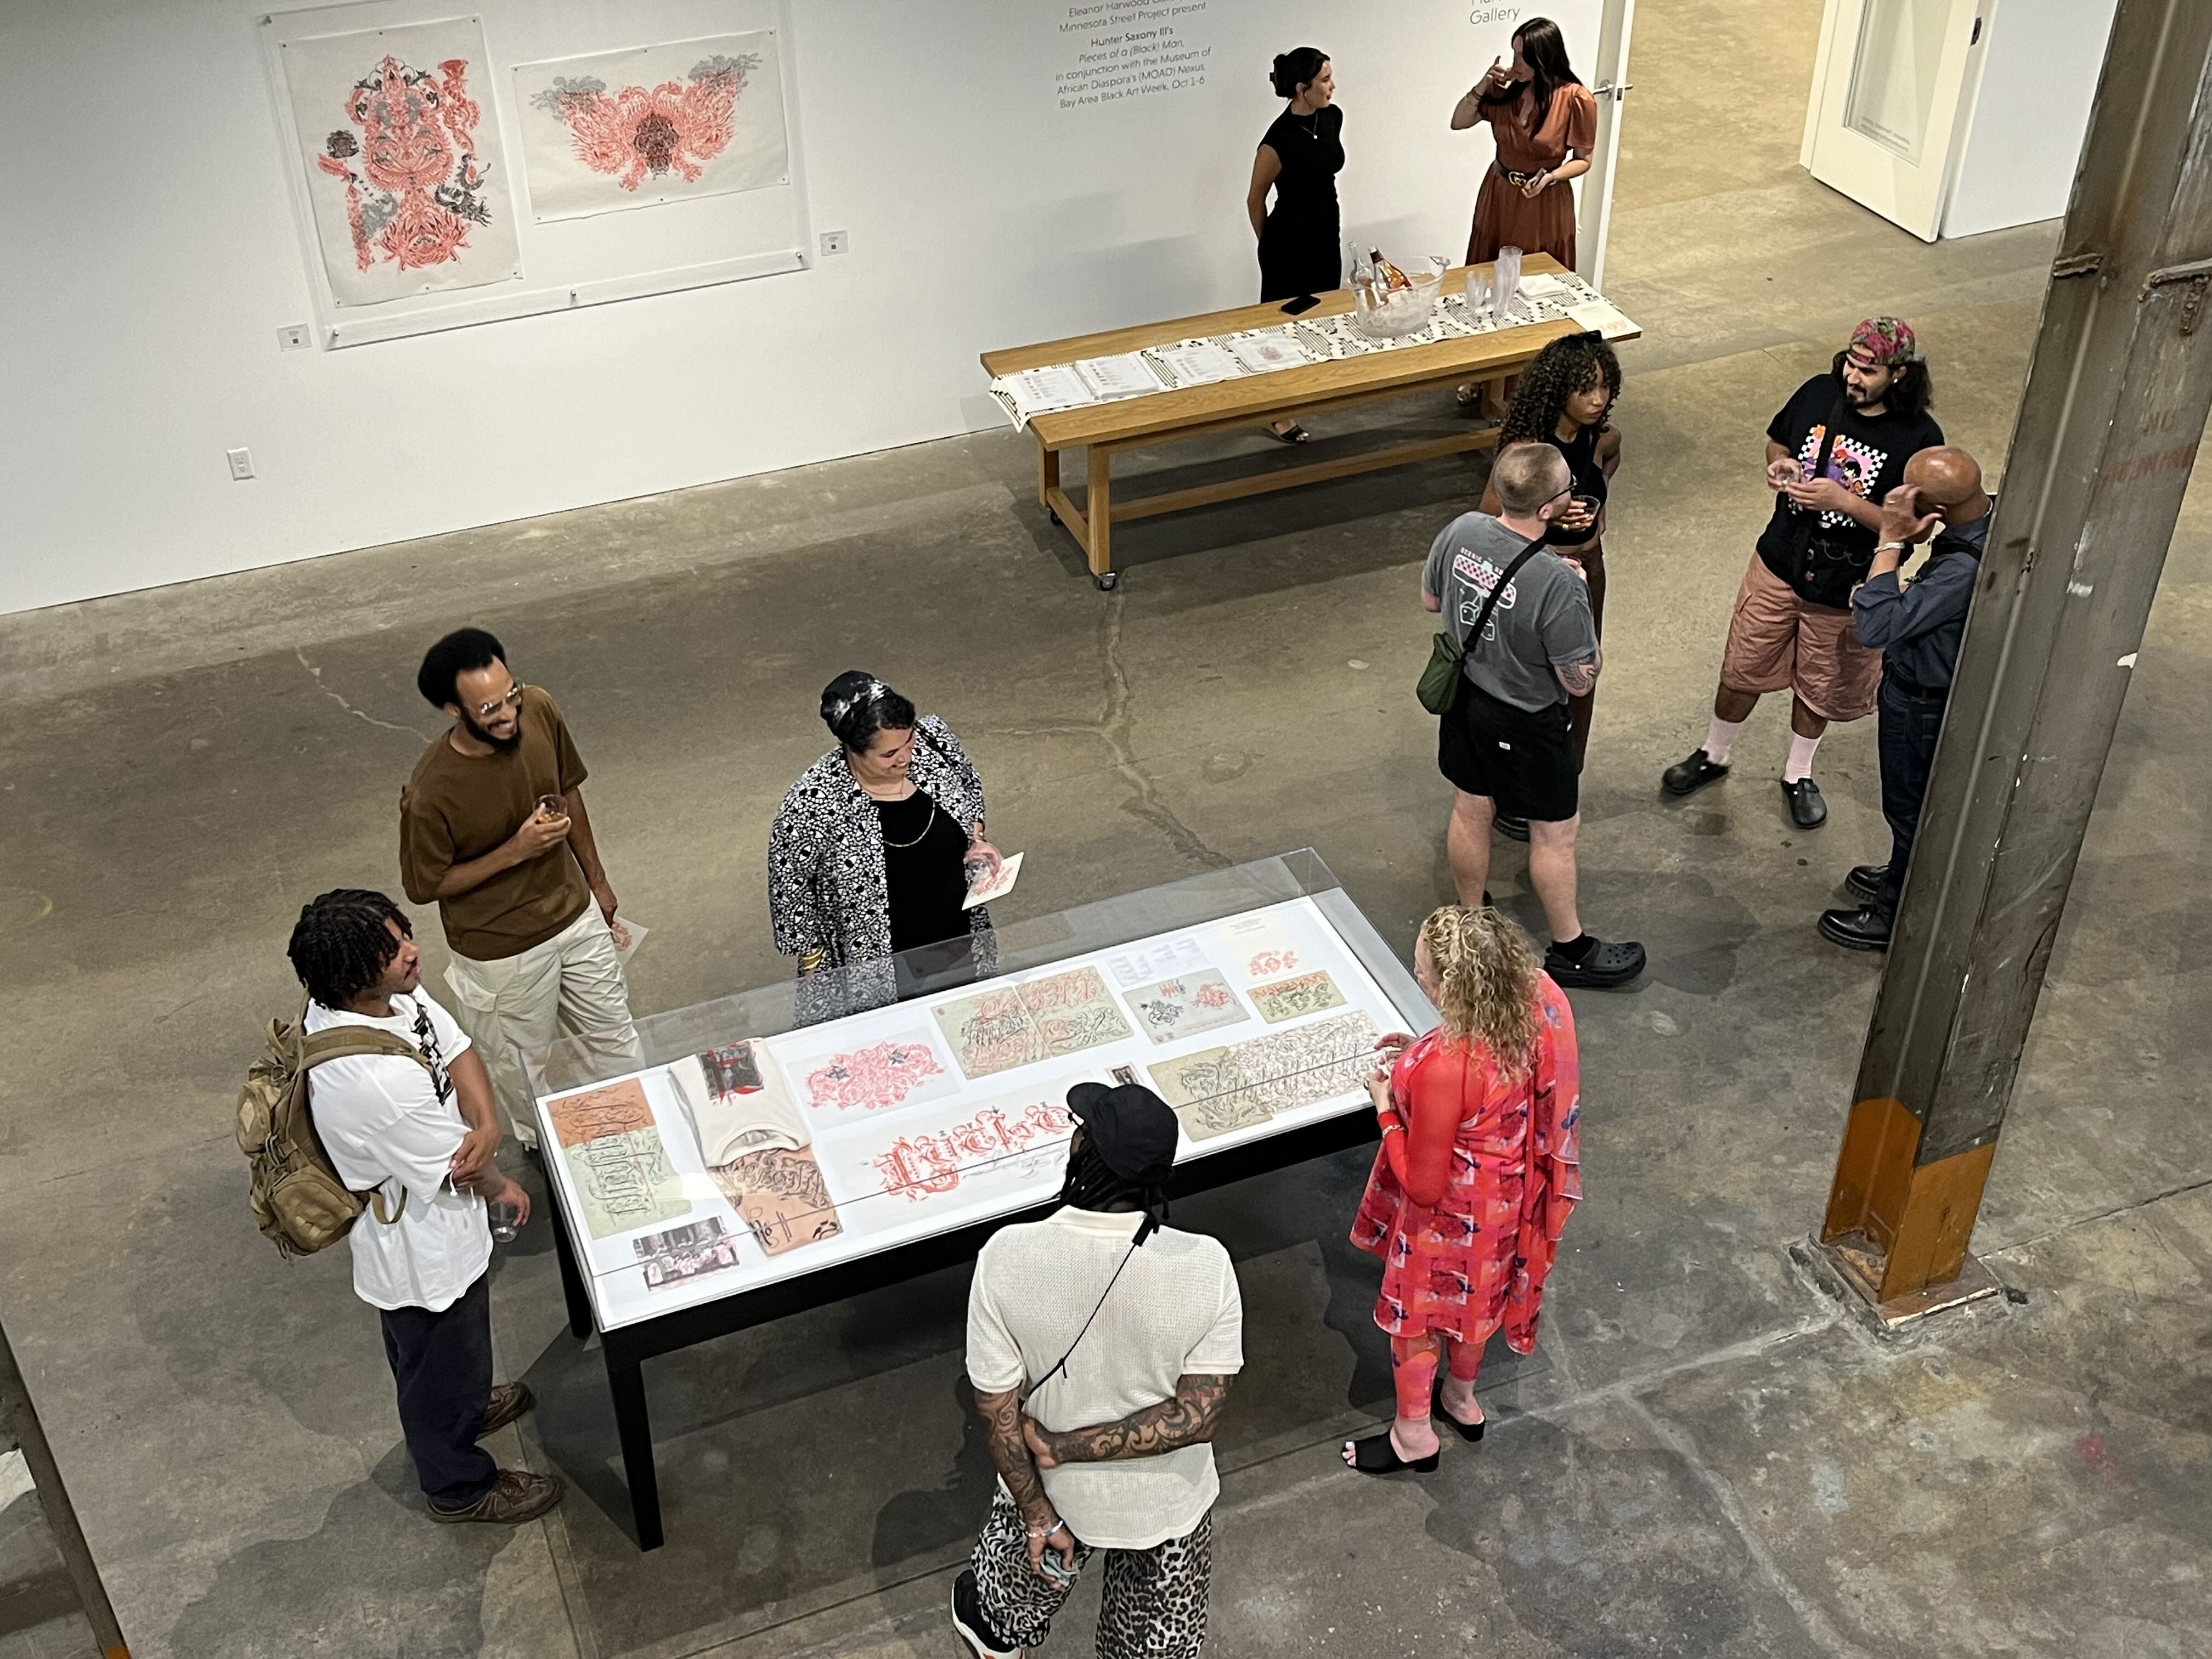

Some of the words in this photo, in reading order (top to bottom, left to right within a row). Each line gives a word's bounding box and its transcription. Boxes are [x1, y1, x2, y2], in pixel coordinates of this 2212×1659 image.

[1059, 19, 1107, 32] Minnesota
[1110, 13, 1136, 25] Street
[1138, 8, 1169, 20] Project
[1172, 2, 1206, 16] present
[1069, 5, 1104, 18] Eleanor
[1470, 8, 1520, 24] Gallery
[1079, 52, 1107, 64] Pieces
[1109, 48, 1119, 58] of
[1130, 42, 1159, 57] (Black)
[1163, 40, 1184, 49] Man,
[1091, 36, 1122, 47] Hunter
[1125, 31, 1157, 42] Saxony
[1056, 72, 1064, 81] in
[1066, 64, 1119, 80] conjunction
[1122, 59, 1141, 70] with
[1143, 57, 1158, 66] the
[1160, 50, 1199, 64] Museum
[1201, 46, 1211, 57] of
[1057, 83, 1088, 95] African
[1091, 75, 1137, 89] Diaspora's
[1139, 67, 1176, 82] (MOAD)
[1178, 64, 1206, 75] Nexus,
[1060, 99, 1076, 109] Bay
[1077, 95, 1098, 105] Area
[1101, 89, 1124, 101] Black
[1126, 87, 1138, 97] Art
[1141, 82, 1169, 94] Week,
[1172, 78, 1188, 89] Oct
[1190, 75, 1205, 86] 1-6
